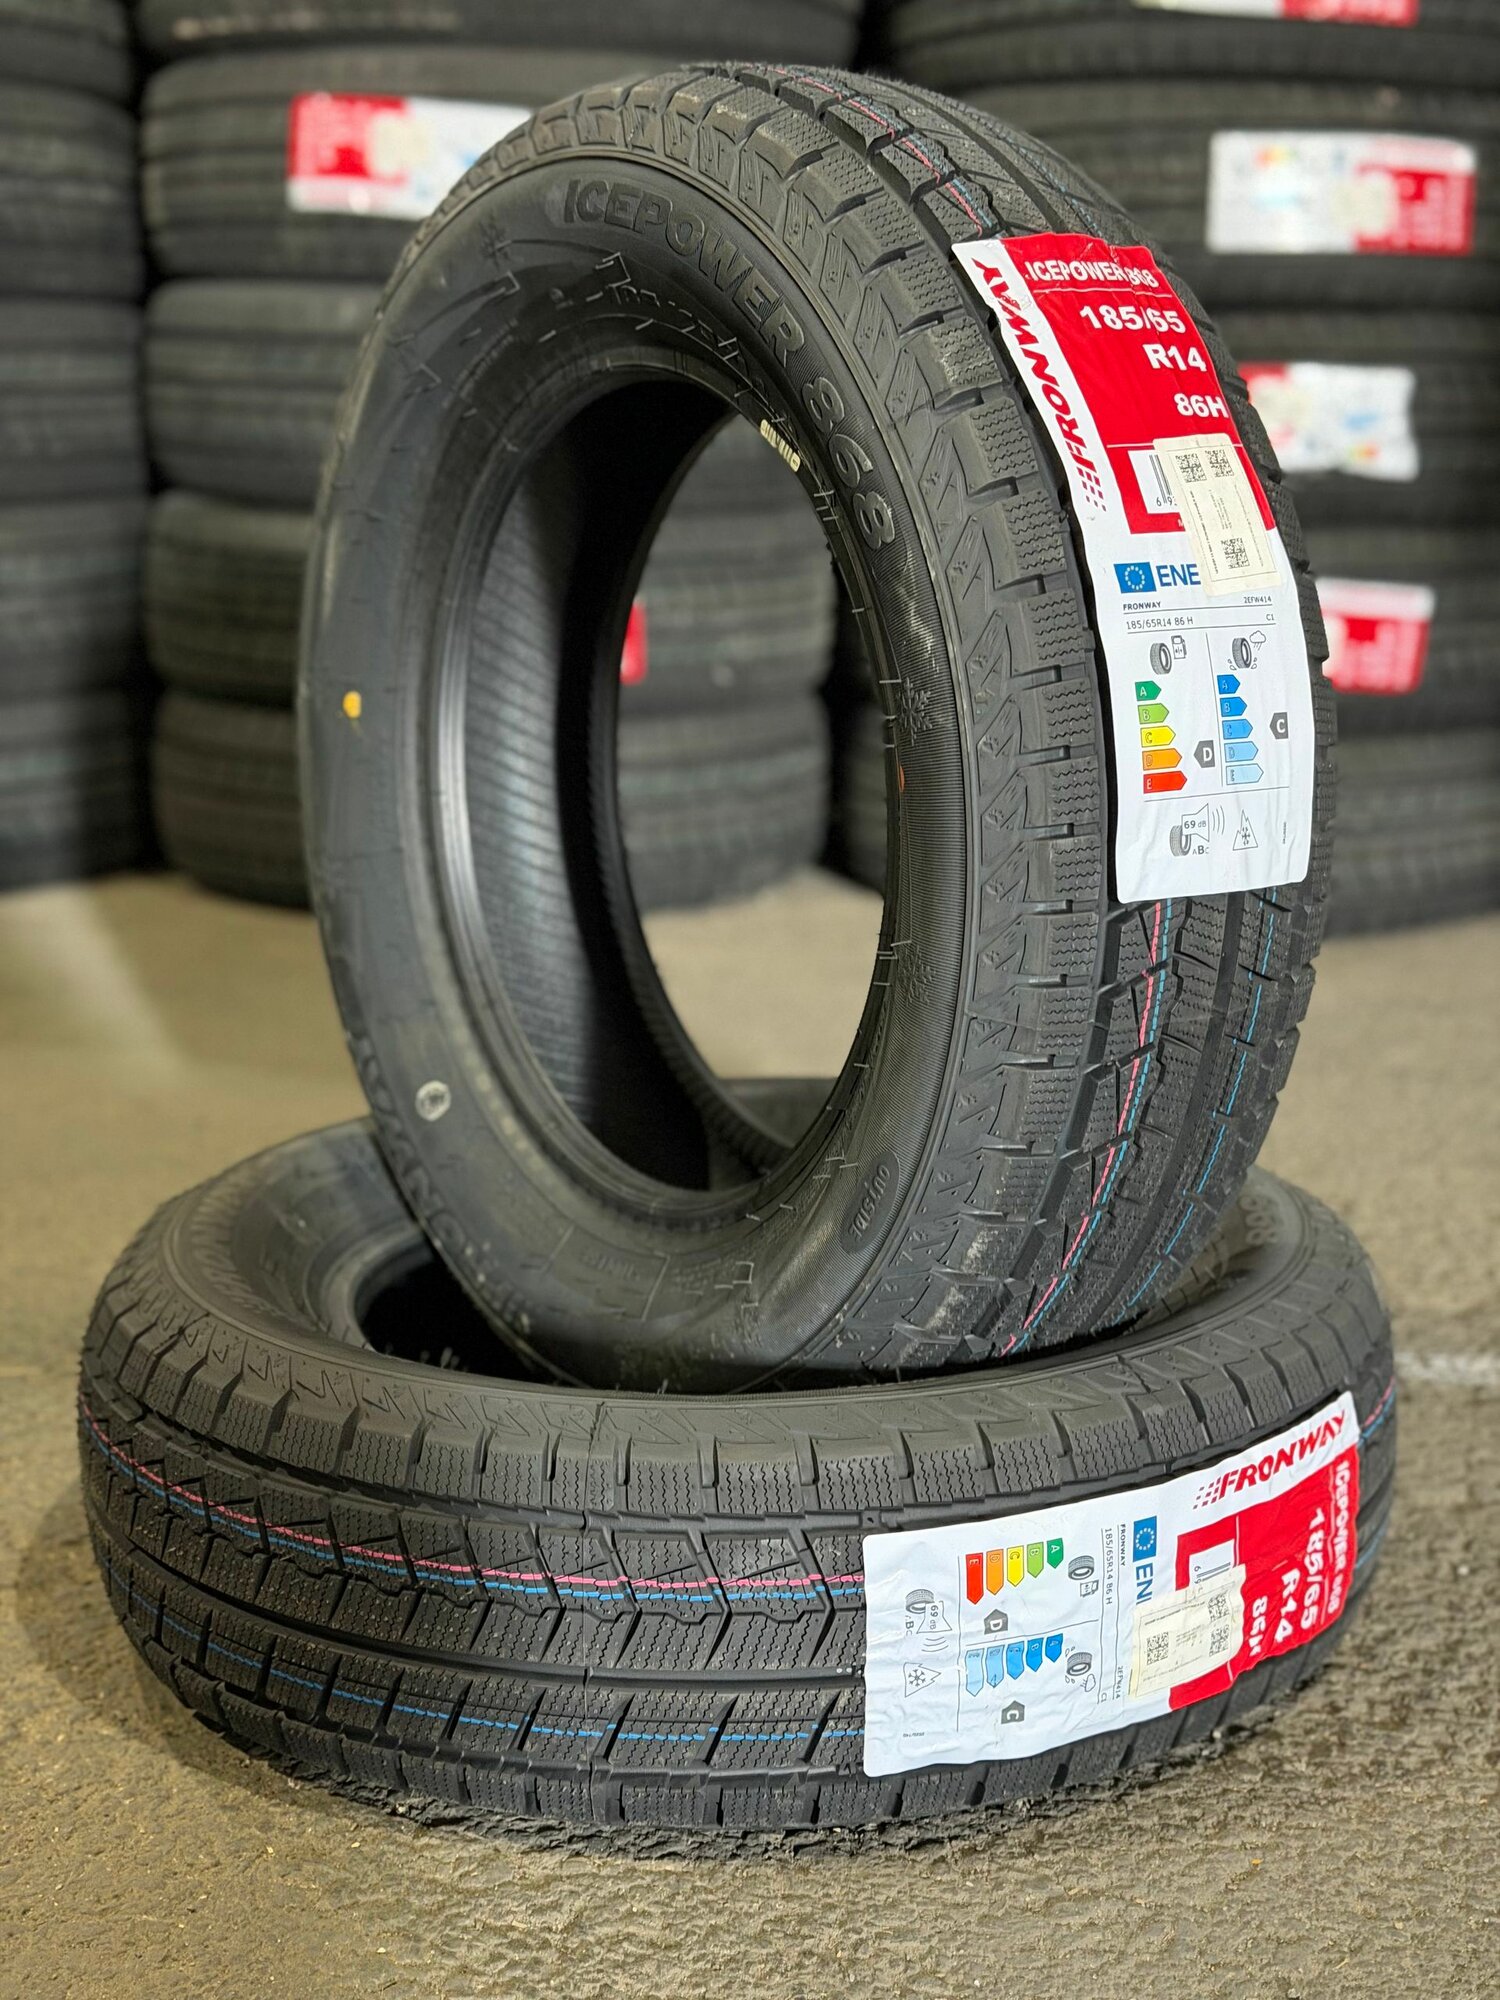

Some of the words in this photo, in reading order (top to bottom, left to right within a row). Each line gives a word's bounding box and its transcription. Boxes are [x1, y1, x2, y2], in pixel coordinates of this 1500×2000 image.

[1026, 260, 1127, 283] ICEPOWER
[1079, 304, 1187, 334] 185/65
[563, 178, 806, 368] ICEPOWER
[801, 376, 896, 549] 868
[971, 257, 1098, 474] FRONWAY
[1143, 343, 1208, 372] R14
[1174, 393, 1230, 419] 86H
[1155, 563, 1202, 588] ENE
[1123, 601, 1162, 612] FRONWAY
[1125, 616, 1172, 630] 185/65R14
[1174, 617, 1186, 627] 86
[1187, 616, 1194, 625] H
[1265, 613, 1275, 622] C1
[1140, 687, 1147, 697] A
[1142, 709, 1151, 721] B
[1276, 718, 1286, 733] C
[1202, 747, 1213, 762] D
[1184, 820, 1196, 830] 69
[1219, 1410, 1346, 1501] FRONWAY
[1334, 1460, 1350, 1574] ICEPOWER
[1105, 1528, 1114, 1580] 185/65R14
[1300, 1507, 1325, 1630] 185/65
[1105, 1583, 1113, 1595] 86
[930, 1604, 938, 1618] 69
[1274, 1568, 1301, 1643] R14
[989, 1619, 1002, 1631] D
[1006, 1709, 1020, 1721] C
